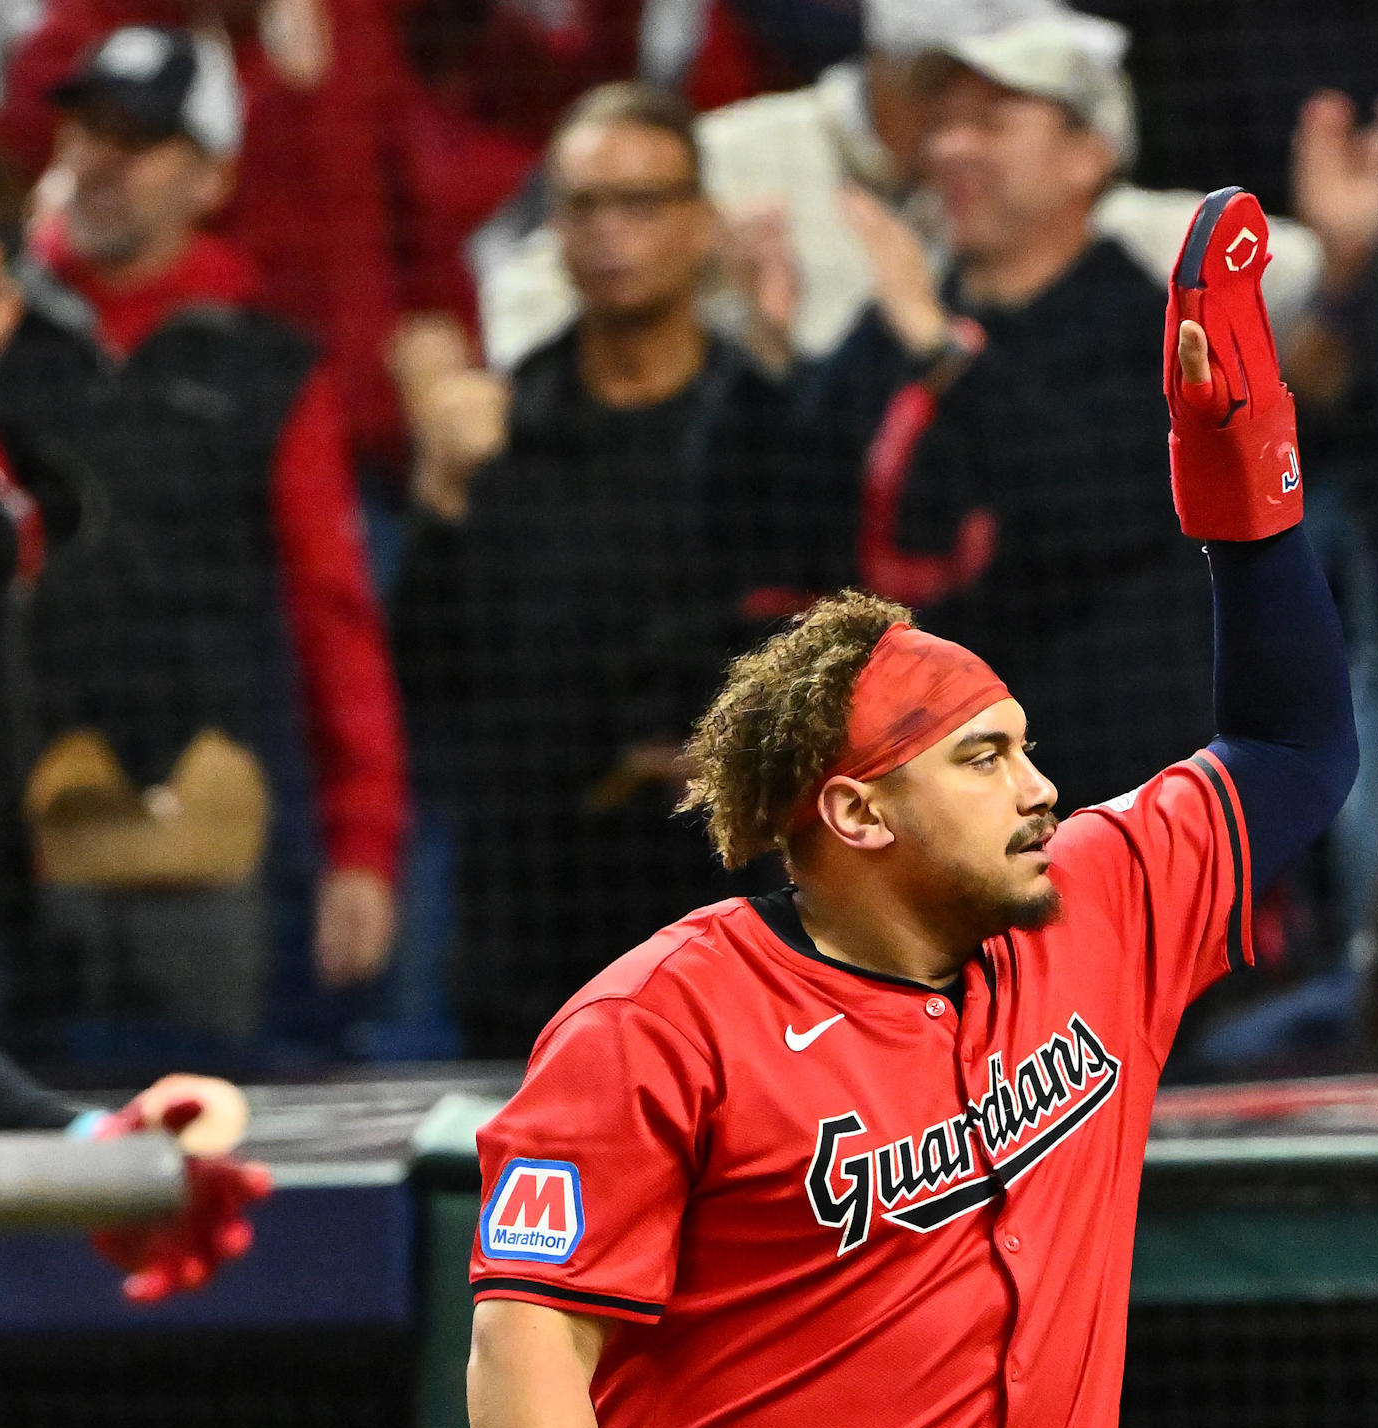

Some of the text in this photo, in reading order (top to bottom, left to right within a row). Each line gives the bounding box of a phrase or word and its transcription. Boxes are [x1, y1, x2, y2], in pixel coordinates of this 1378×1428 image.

[805, 1012, 1121, 1257] Guardians
[497, 1173, 567, 1232] M
[492, 1228, 567, 1250] Marathon
